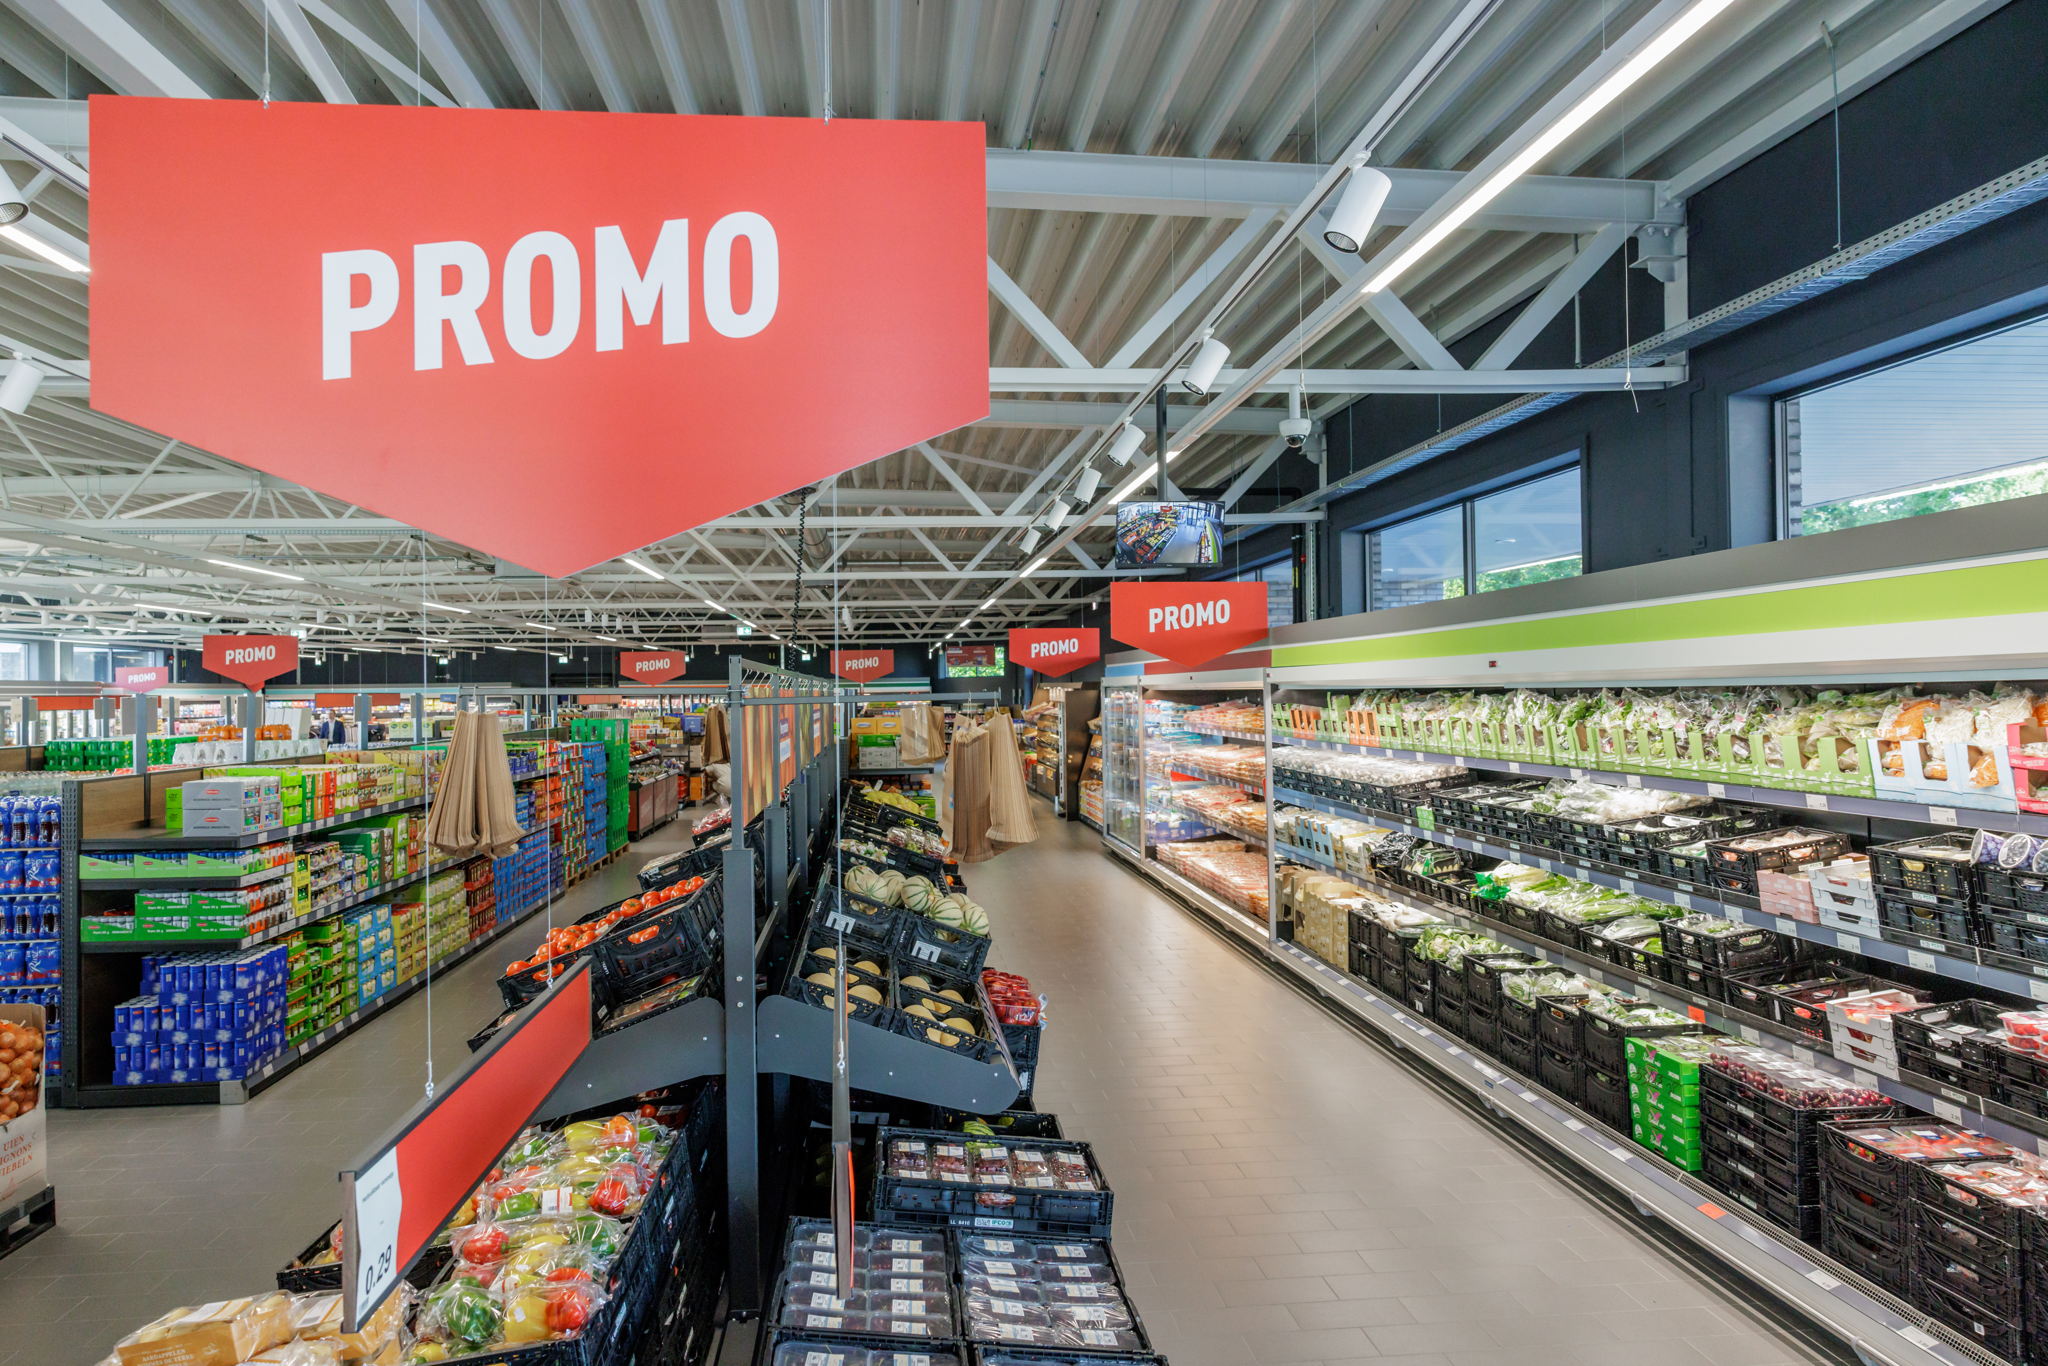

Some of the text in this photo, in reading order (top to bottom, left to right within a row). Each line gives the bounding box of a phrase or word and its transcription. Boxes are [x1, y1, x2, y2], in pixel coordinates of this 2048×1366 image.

[321, 211, 780, 381] PROMO
[1148, 599, 1231, 633] PROMO
[225, 644, 276, 665] PROMO
[1030, 638, 1079, 659] PROMO
[635, 656, 671, 673] PROMO
[845, 655, 880, 672] PROMO
[127, 671, 157, 684] PROMO
[0, 1152, 33, 1177] IEBELN
[364, 1244, 393, 1296] 0.29
